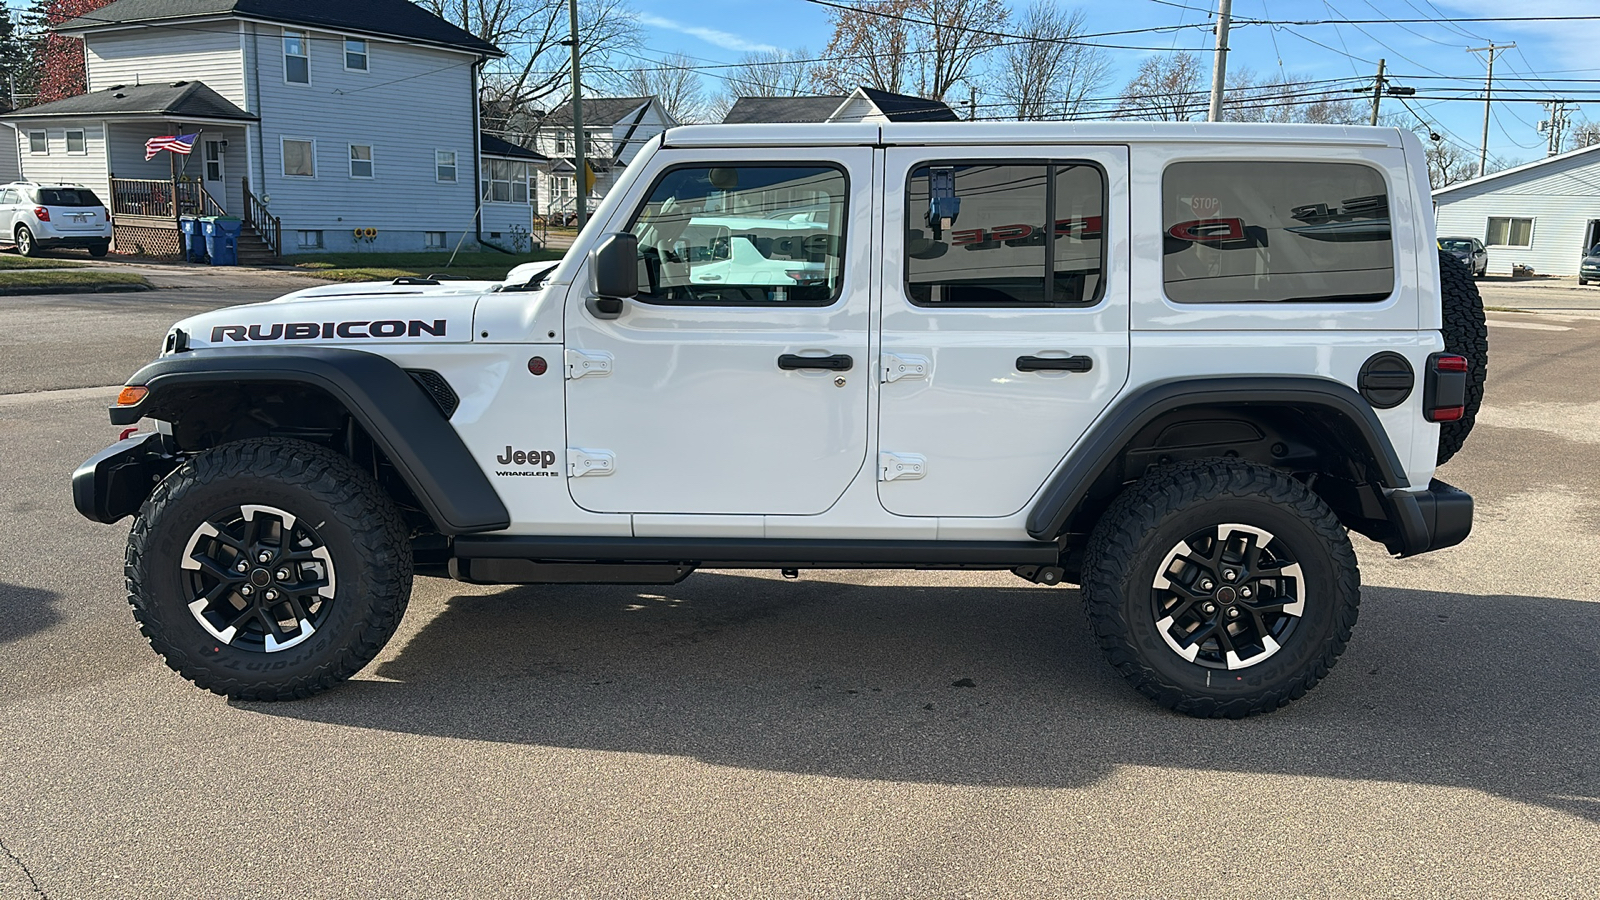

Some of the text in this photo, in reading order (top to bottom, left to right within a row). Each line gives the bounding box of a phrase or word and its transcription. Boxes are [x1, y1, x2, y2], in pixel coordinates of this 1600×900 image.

[1192, 197, 1219, 210] STOP
[210, 319, 447, 342] RUBICON
[496, 445, 556, 469] Jeep
